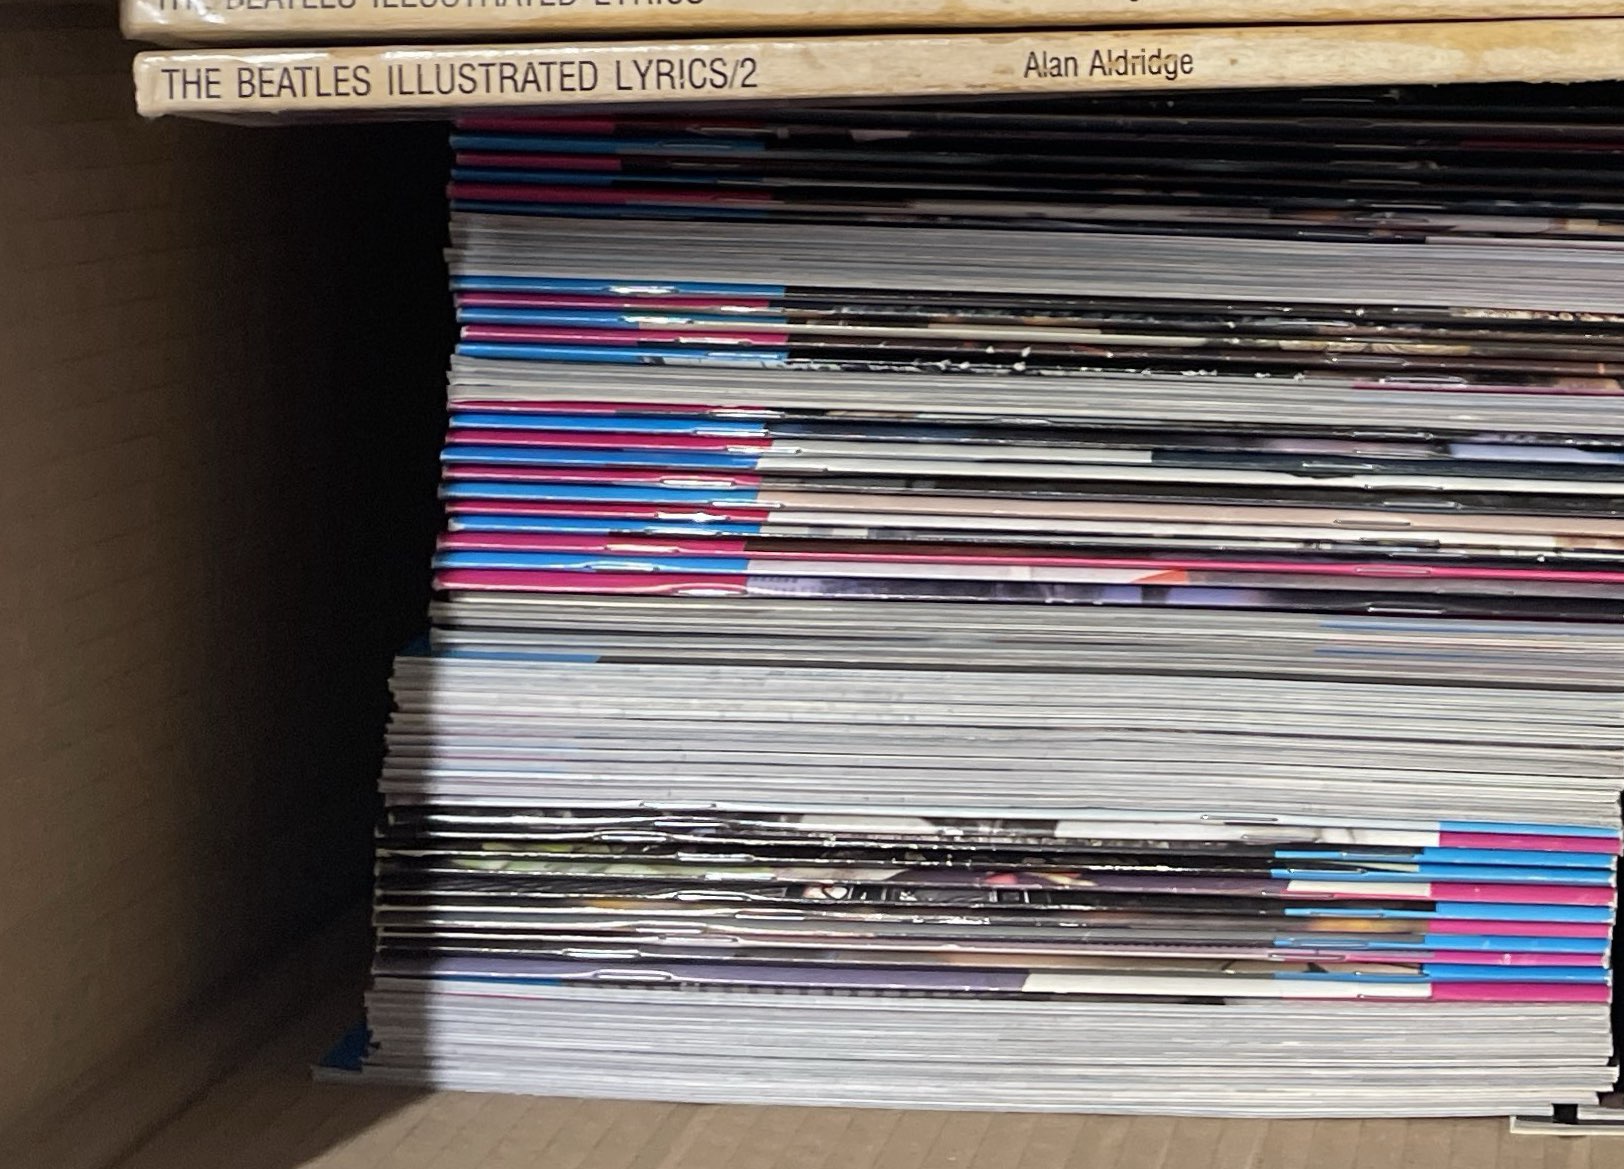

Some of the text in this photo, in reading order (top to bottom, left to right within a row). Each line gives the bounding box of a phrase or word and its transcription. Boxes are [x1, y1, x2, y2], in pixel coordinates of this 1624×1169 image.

[161, 67, 221, 100] THE
[237, 65, 372, 99] BEATLES
[387, 60, 598, 97] ILLUSTRATED
[1022, 48, 1195, 82] Alan Aldridge
